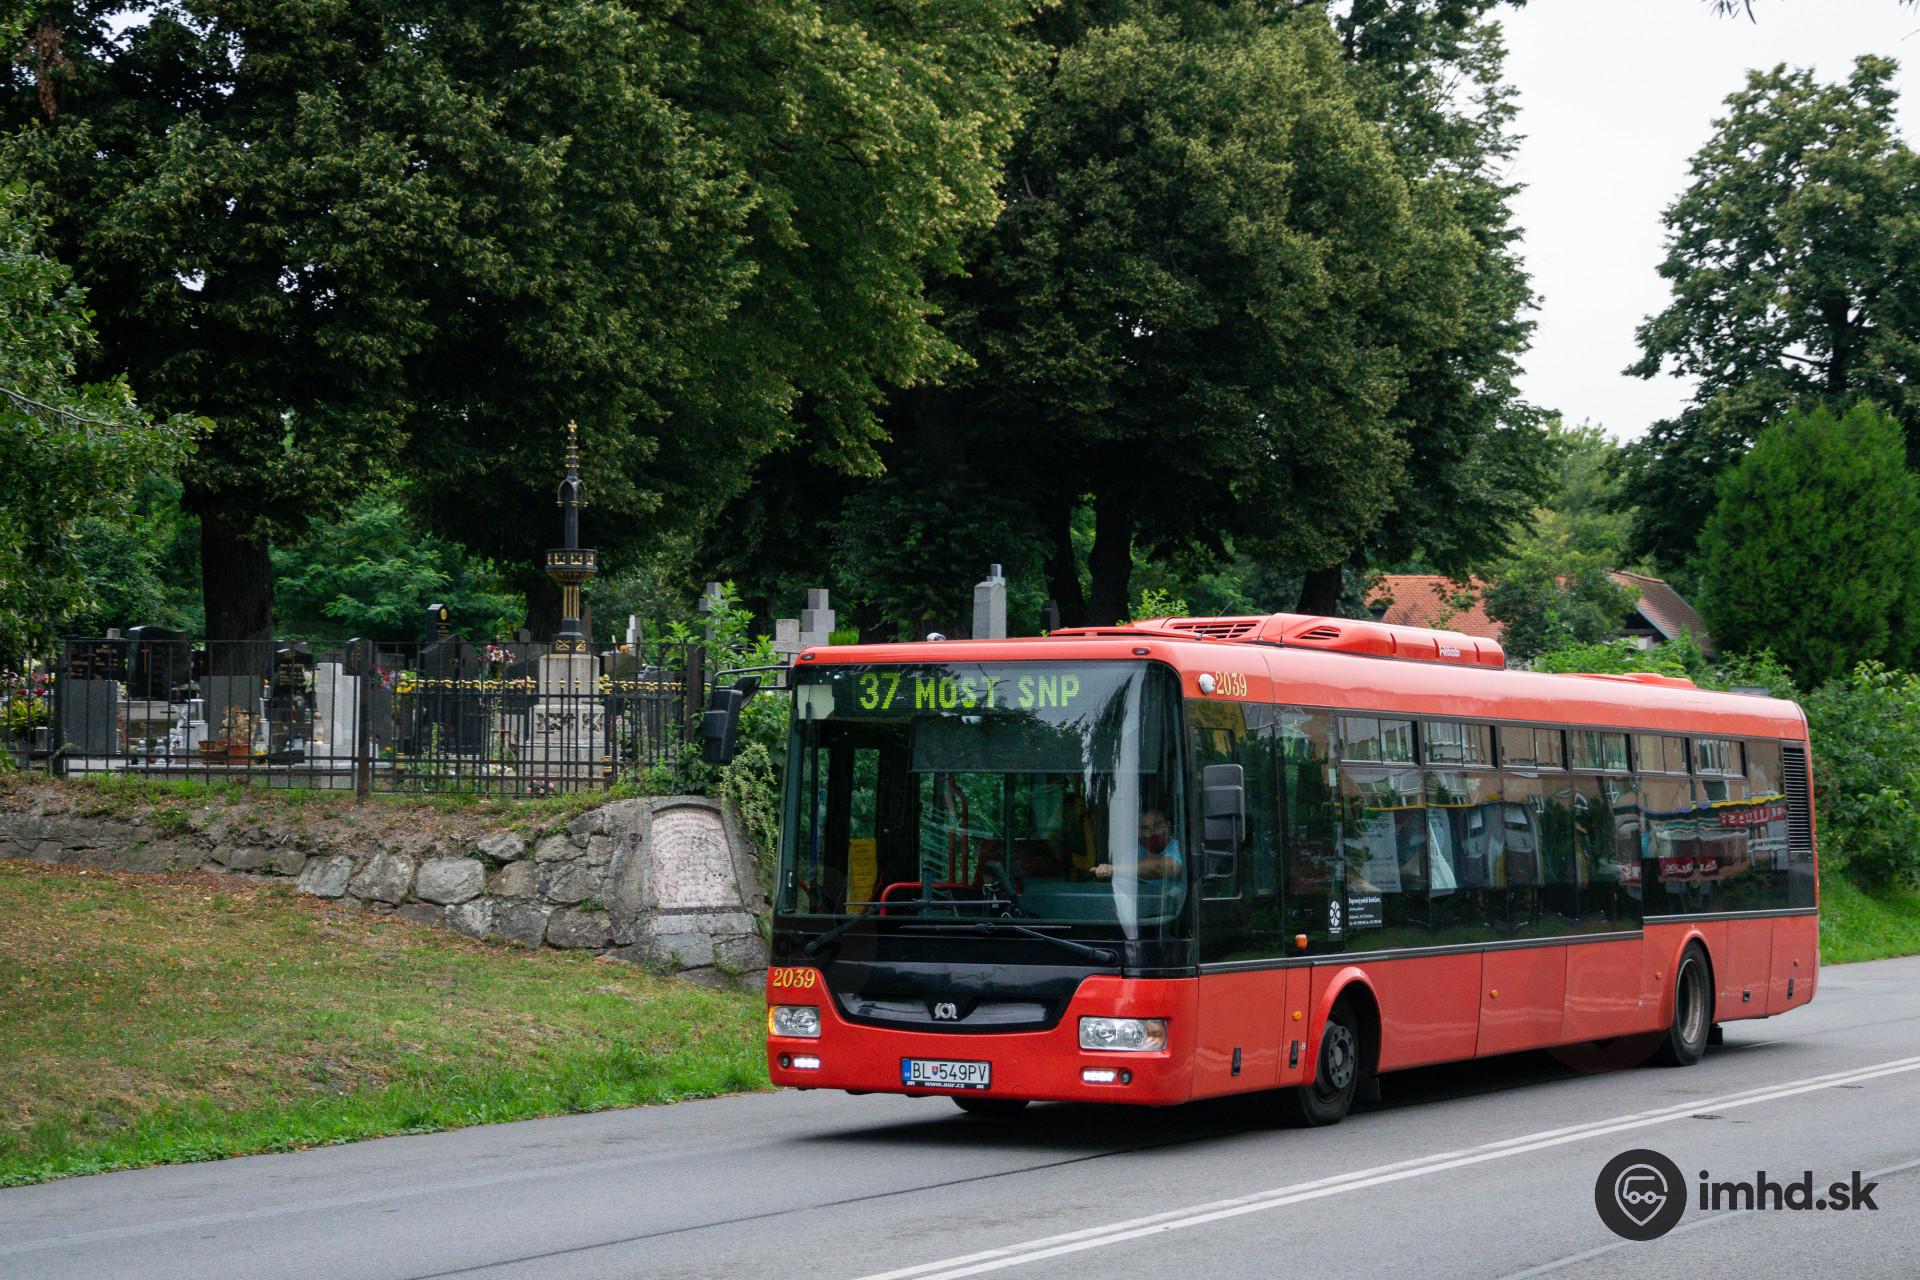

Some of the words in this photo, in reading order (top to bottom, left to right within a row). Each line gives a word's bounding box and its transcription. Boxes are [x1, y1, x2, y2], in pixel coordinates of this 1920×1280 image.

[859, 673, 900, 710] 37
[915, 676, 1000, 709] MOST
[1018, 675, 1080, 707] SNP
[1215, 671, 1247, 697] 2039
[772, 968, 816, 989] 2039
